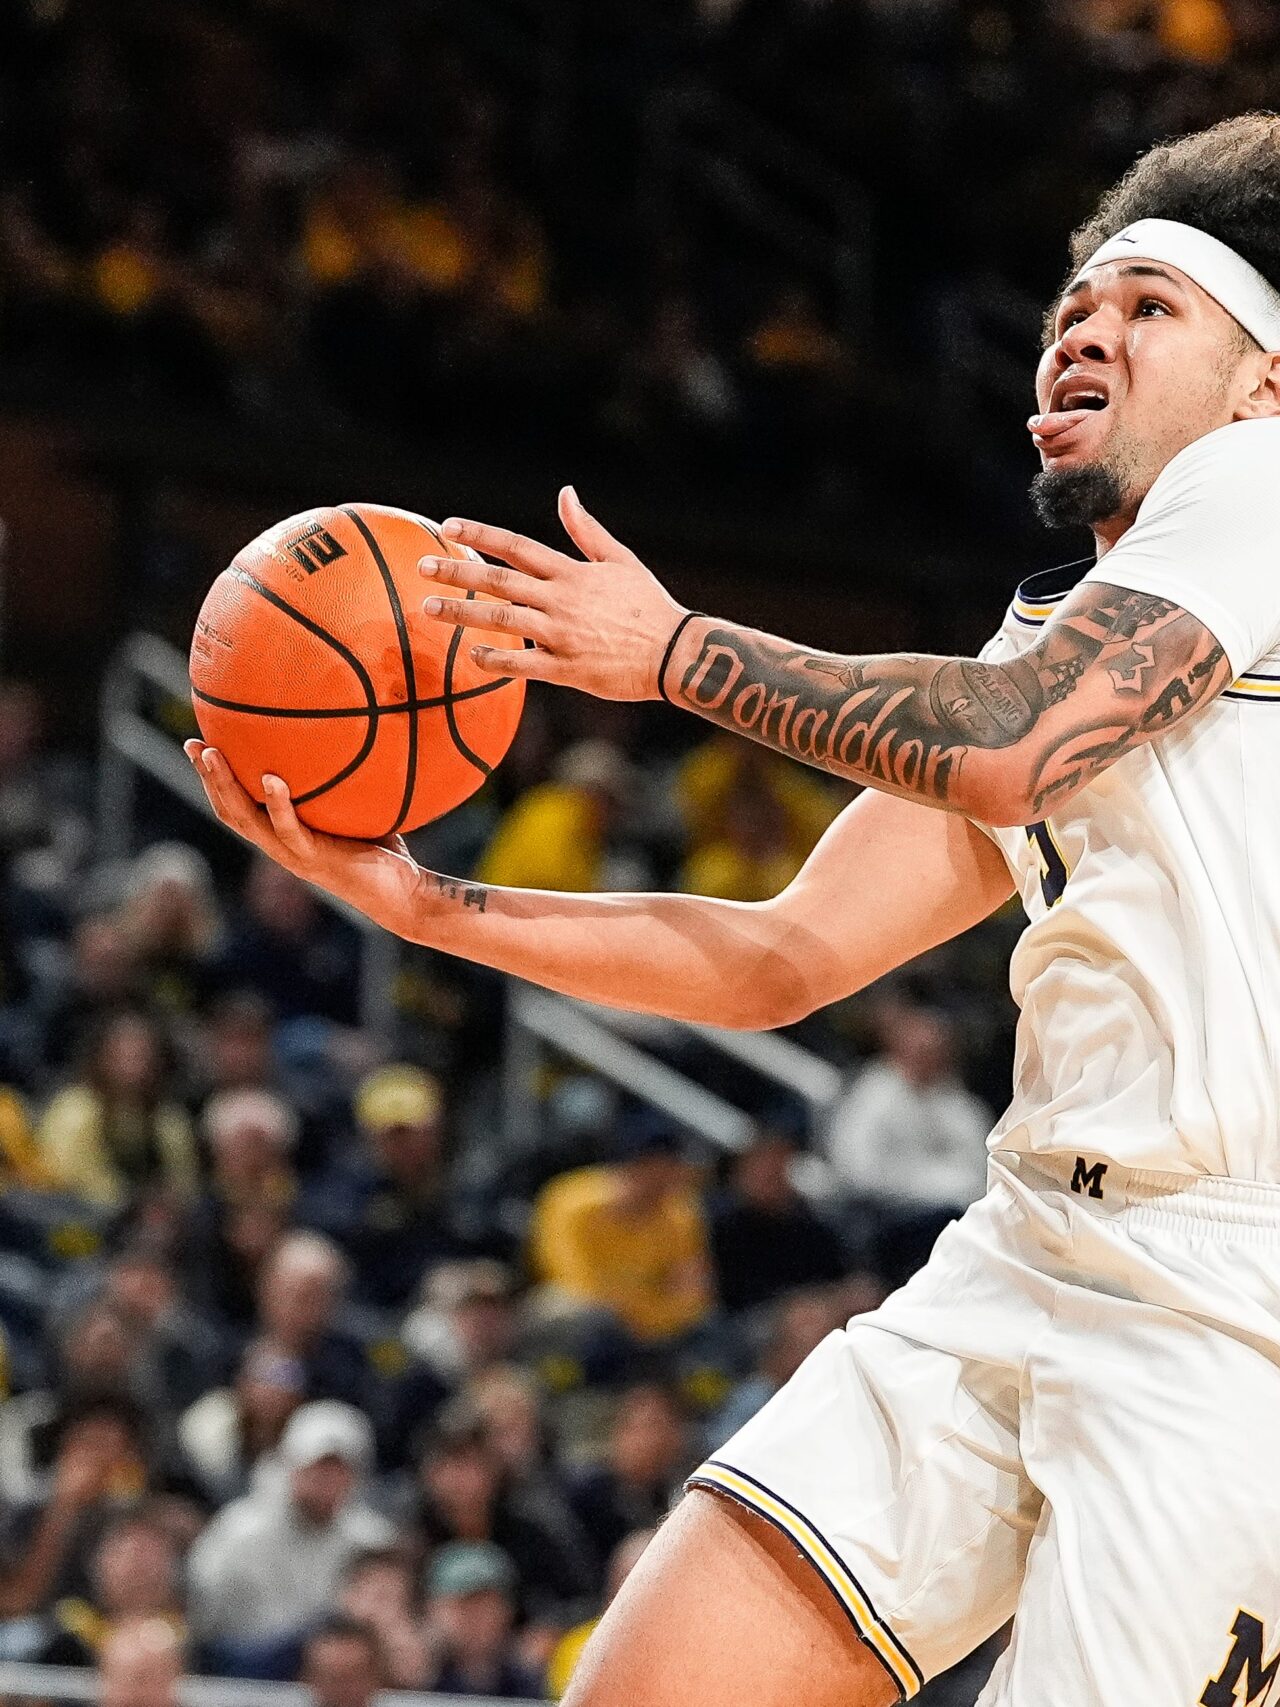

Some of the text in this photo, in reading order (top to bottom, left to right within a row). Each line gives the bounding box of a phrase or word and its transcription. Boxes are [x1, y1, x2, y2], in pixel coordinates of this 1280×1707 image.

[680, 644, 968, 800] Donaldson
[969, 664, 1020, 723] PALDING
[1070, 1155, 1108, 1200] M
